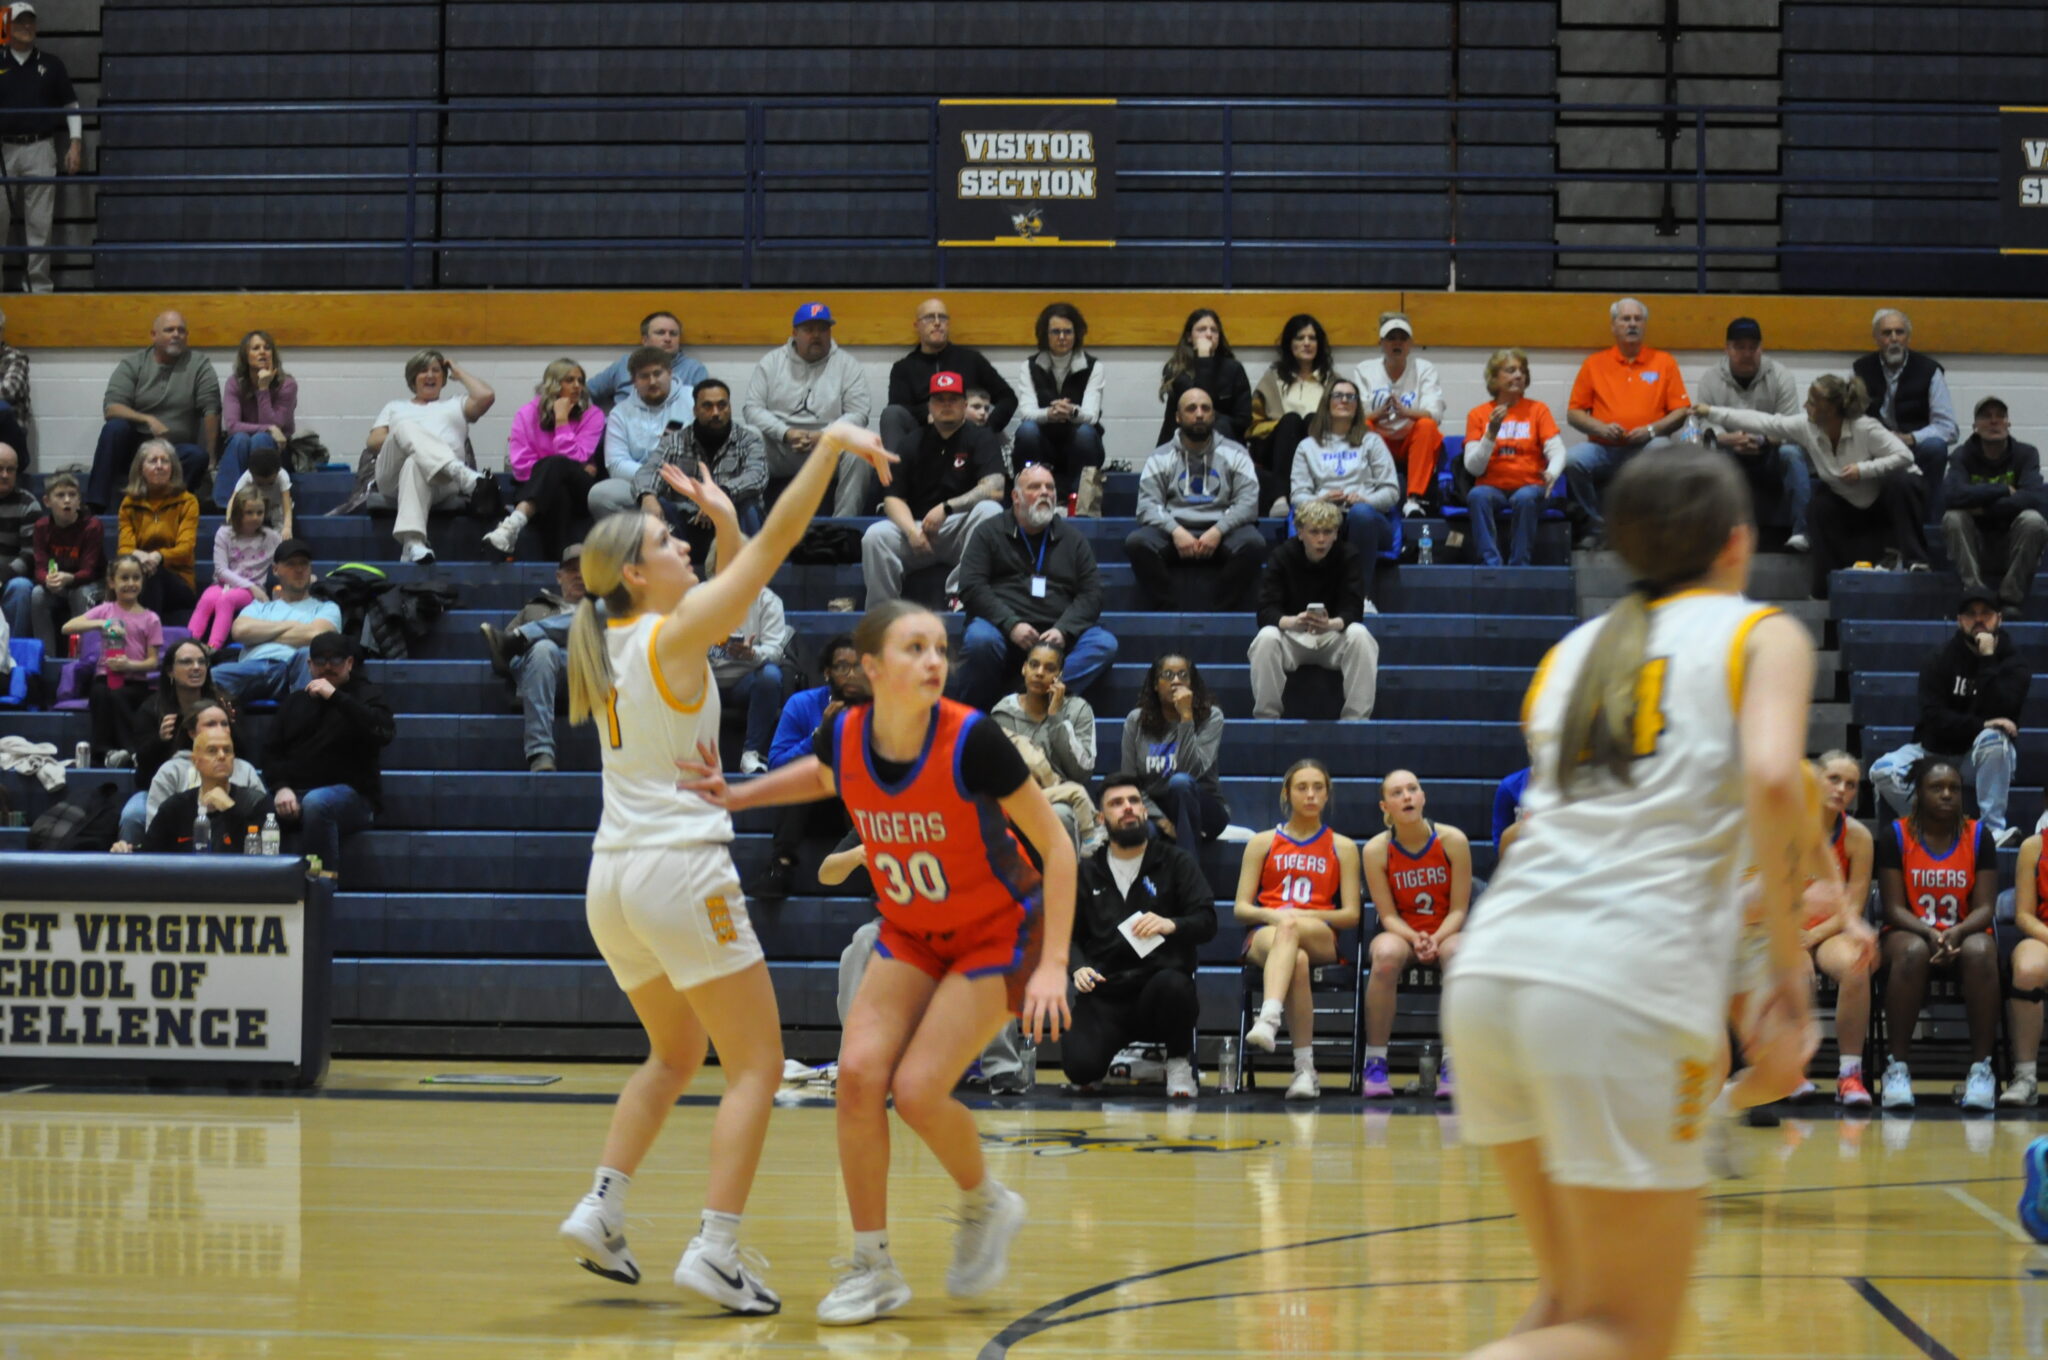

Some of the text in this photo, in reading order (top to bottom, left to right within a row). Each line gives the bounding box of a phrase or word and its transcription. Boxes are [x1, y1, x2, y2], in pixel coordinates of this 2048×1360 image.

[962, 131, 1094, 161] VISITOR
[2021, 138, 2048, 170] V
[959, 168, 1096, 198] SECTION
[853, 807, 947, 844] TIGERS
[874, 851, 950, 905] 30
[1273, 852, 1327, 875] TIGERS
[1393, 865, 1448, 890] TIGERS
[1910, 868, 1968, 889] TIGERS
[1280, 874, 1313, 905] 10
[1414, 891, 1434, 915] 2
[1917, 893, 1959, 927] 33
[74, 913, 288, 955] VIRGINIA
[151, 960, 207, 1001] OF
[0, 1004, 268, 1049] ELLENCE
